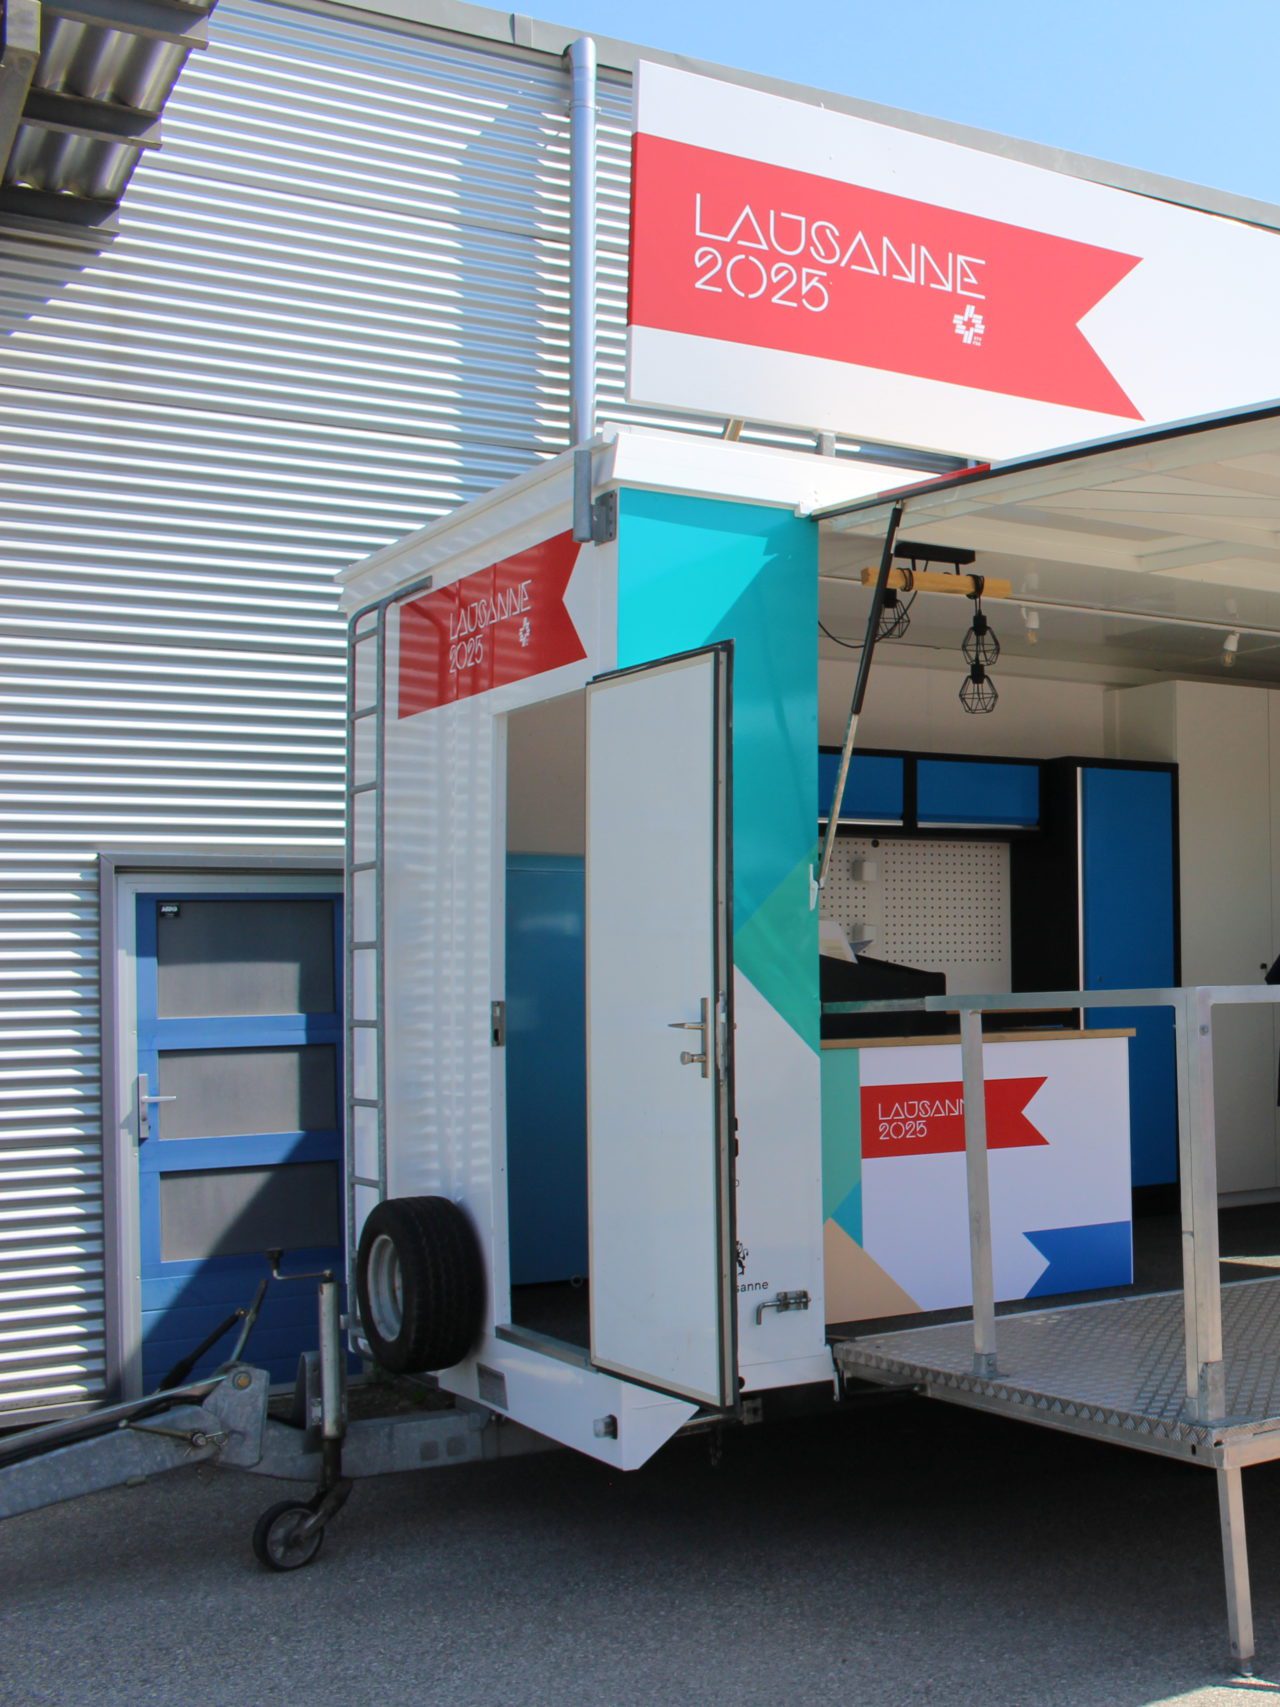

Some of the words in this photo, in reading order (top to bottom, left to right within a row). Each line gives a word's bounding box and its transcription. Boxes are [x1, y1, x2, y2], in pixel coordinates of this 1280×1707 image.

[695, 192, 986, 300] LAUSANNE
[694, 246, 829, 312] 2025
[449, 579, 532, 641] LAUSANNE
[449, 633, 484, 673] 2025
[878, 1098, 965, 1120] LAUSAN
[878, 1120, 928, 1140] 2025
